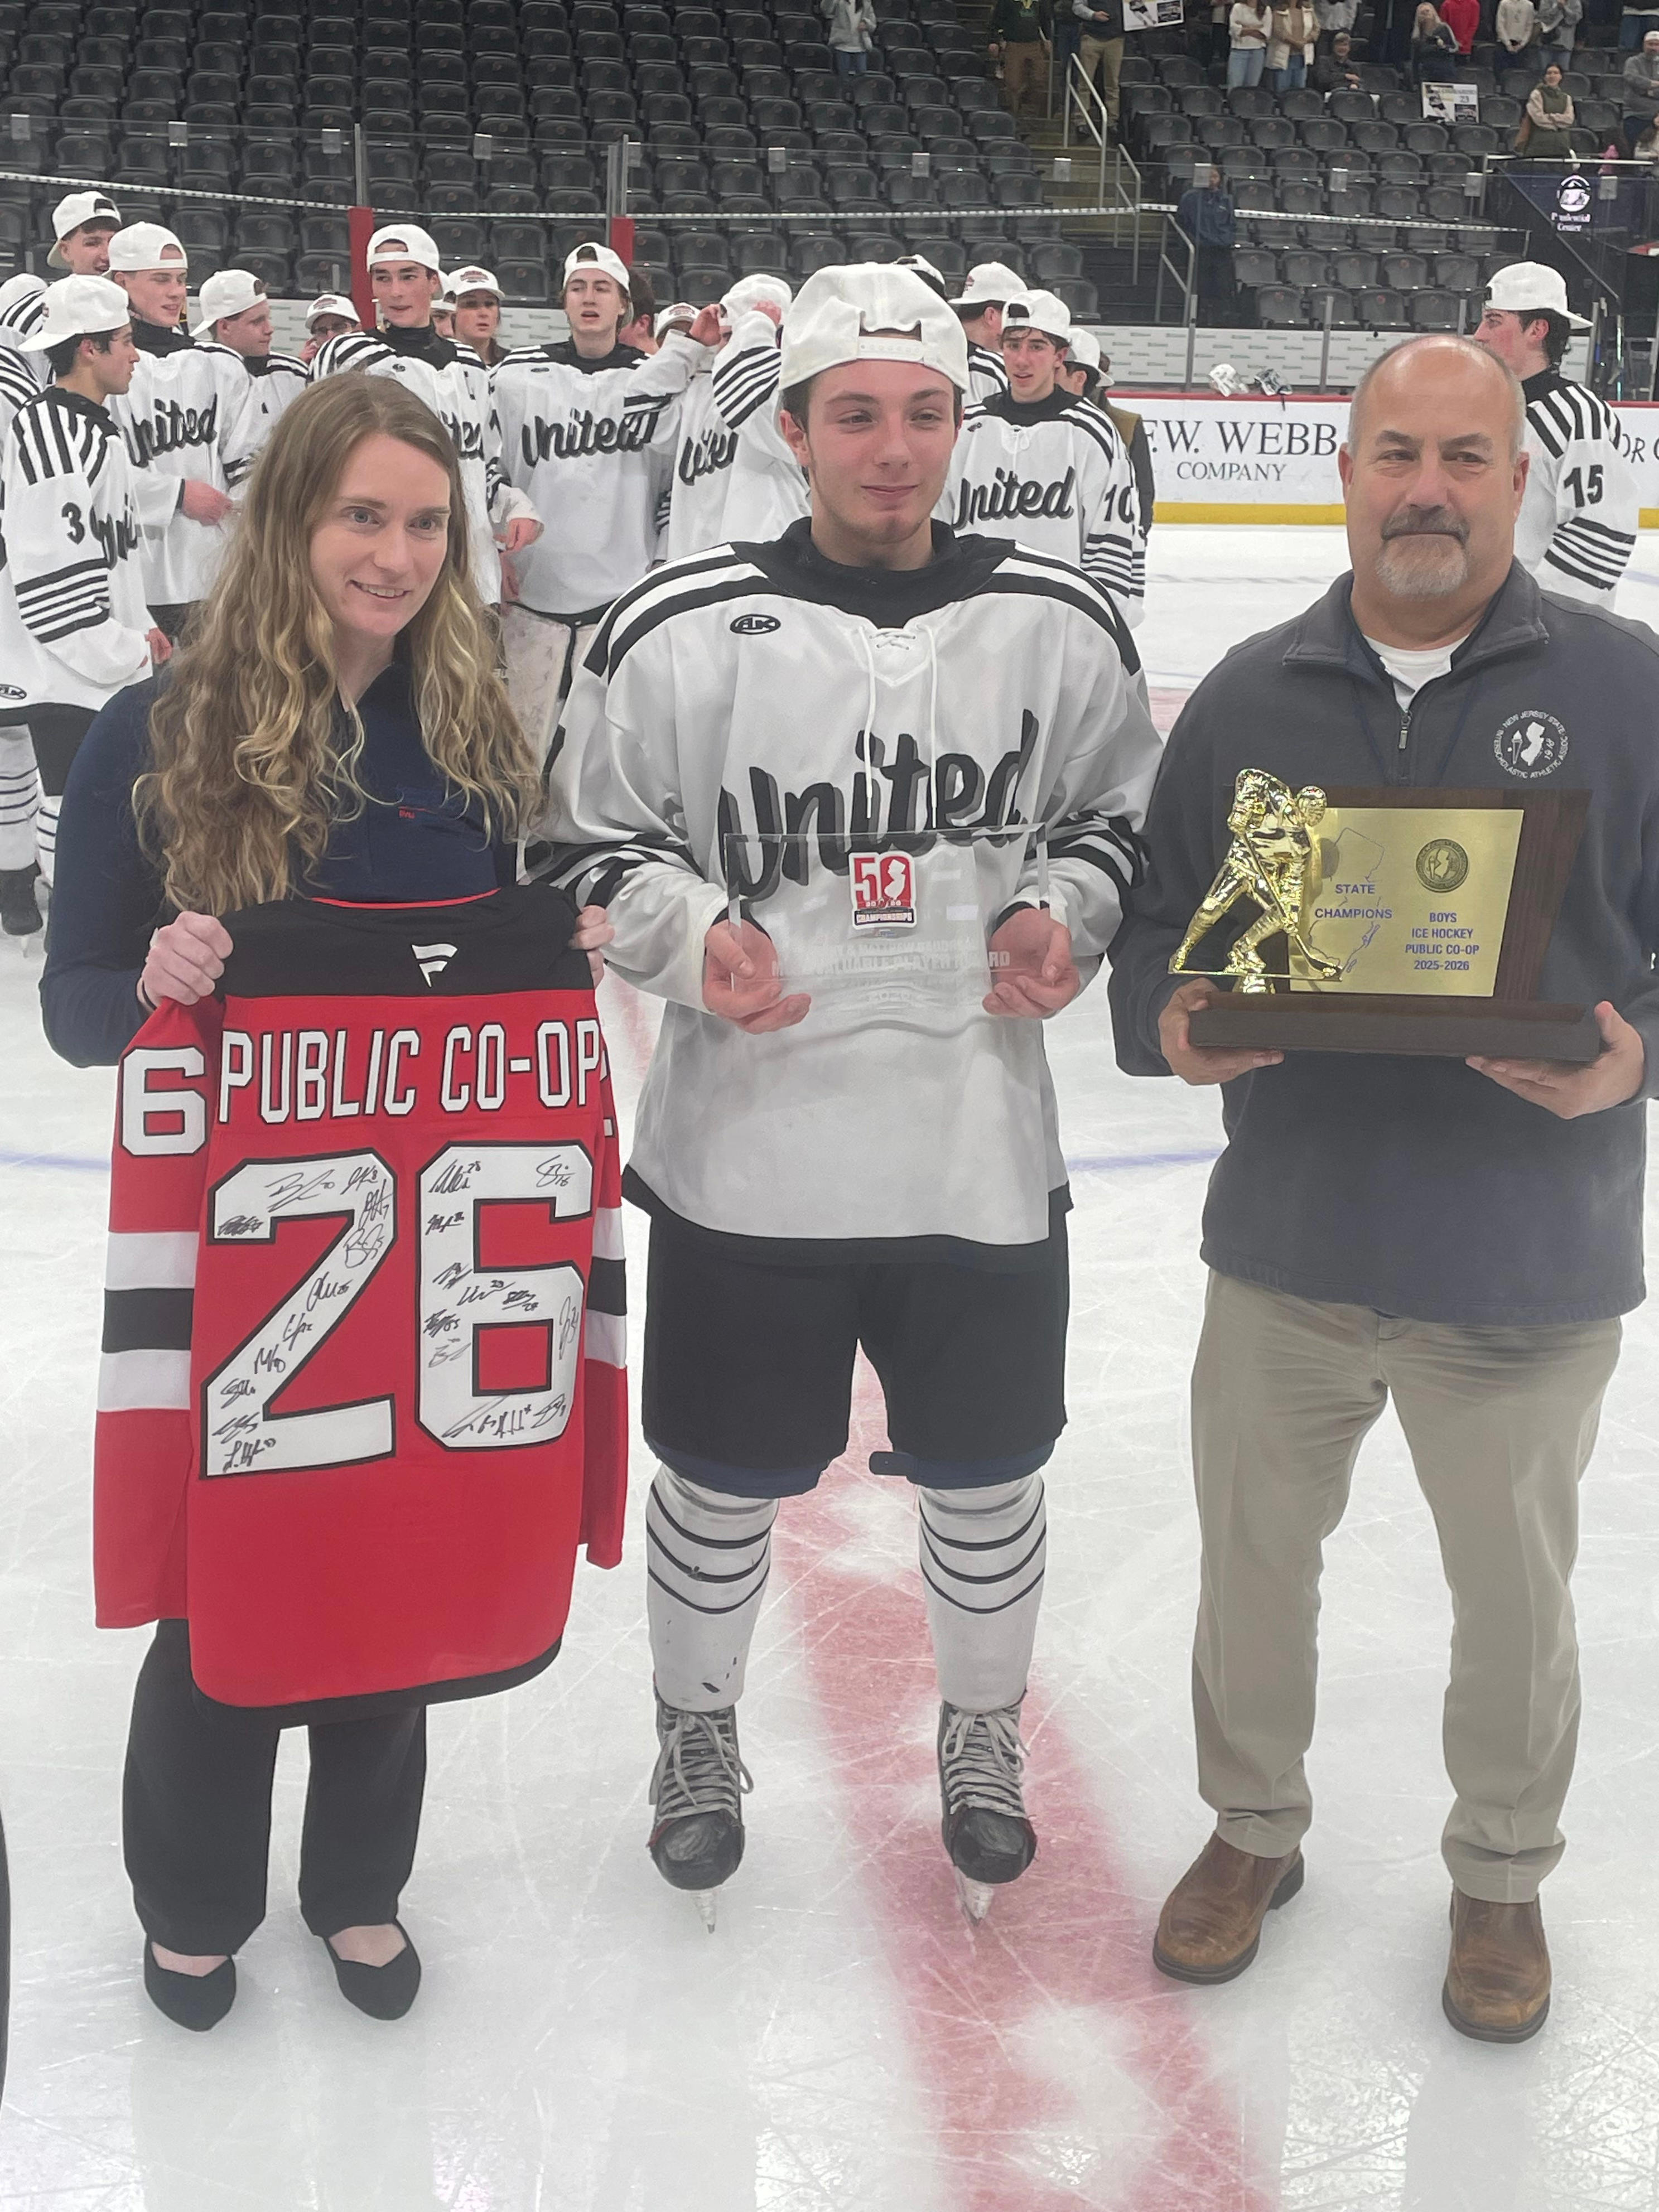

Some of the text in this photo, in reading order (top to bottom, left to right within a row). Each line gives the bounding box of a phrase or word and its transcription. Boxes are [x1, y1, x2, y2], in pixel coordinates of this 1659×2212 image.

[1215, 421, 1337, 456] WEBB
[1176, 462, 1289, 481] COMPANY
[1564, 465, 1603, 508] 15
[61, 502, 85, 544] 3
[1502, 710, 1566, 735] NEW JERSEY STATE
[717, 708, 1039, 902] United
[1335, 884, 1375, 894] STATE
[1315, 908, 1392, 919] CHAMPIONS
[1429, 912, 1457, 923] BOYS
[1412, 928, 1473, 938] ICE HOCKEY
[1405, 944, 1479, 955] PUBLIC CO-OP
[1414, 960, 1469, 970] 2025-2026
[219, 1028, 420, 1124] PUBLIC
[441, 1018, 600, 1112] CO-OP
[121, 1046, 207, 1156] 6
[199, 1140, 594, 1480] 26
